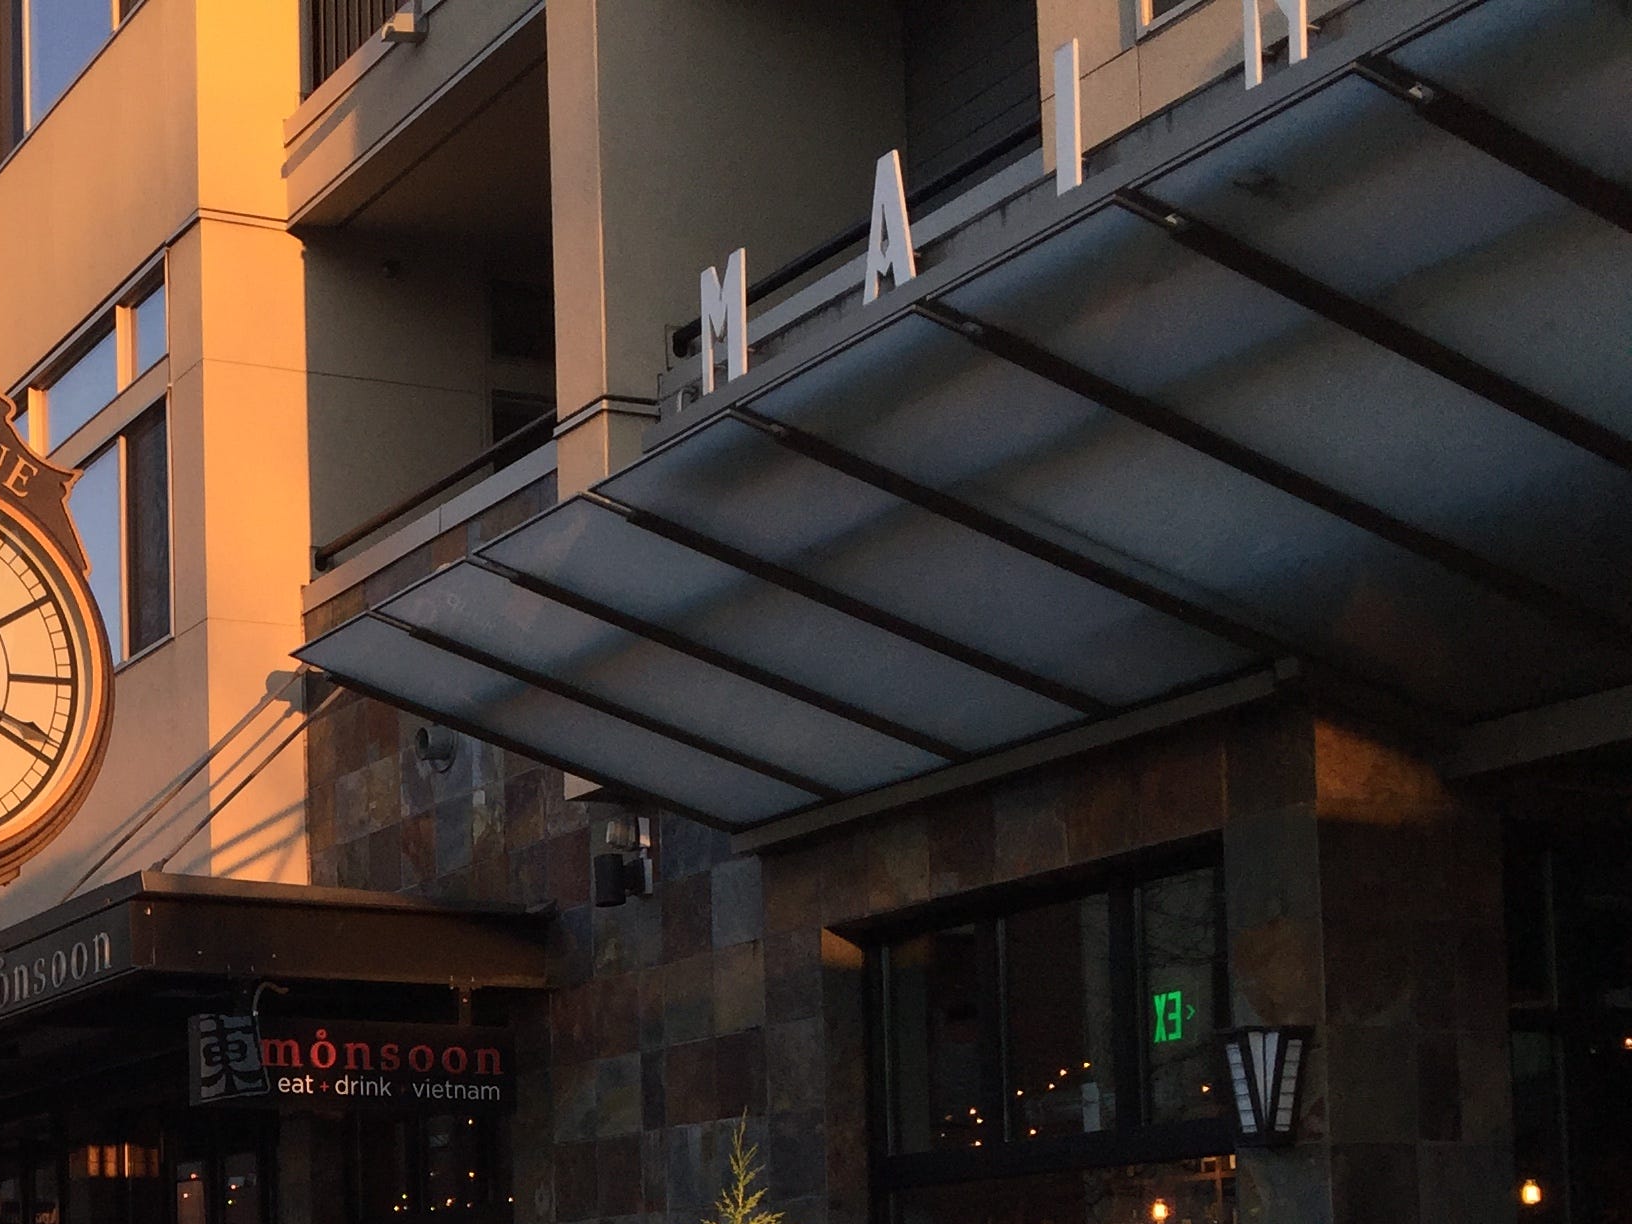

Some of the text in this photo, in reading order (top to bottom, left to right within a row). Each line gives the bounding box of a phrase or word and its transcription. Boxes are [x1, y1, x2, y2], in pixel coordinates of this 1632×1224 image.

[277, 1075, 314, 1094] eat
[335, 1075, 392, 1096] drink
[412, 1080, 501, 1101] vietnam
